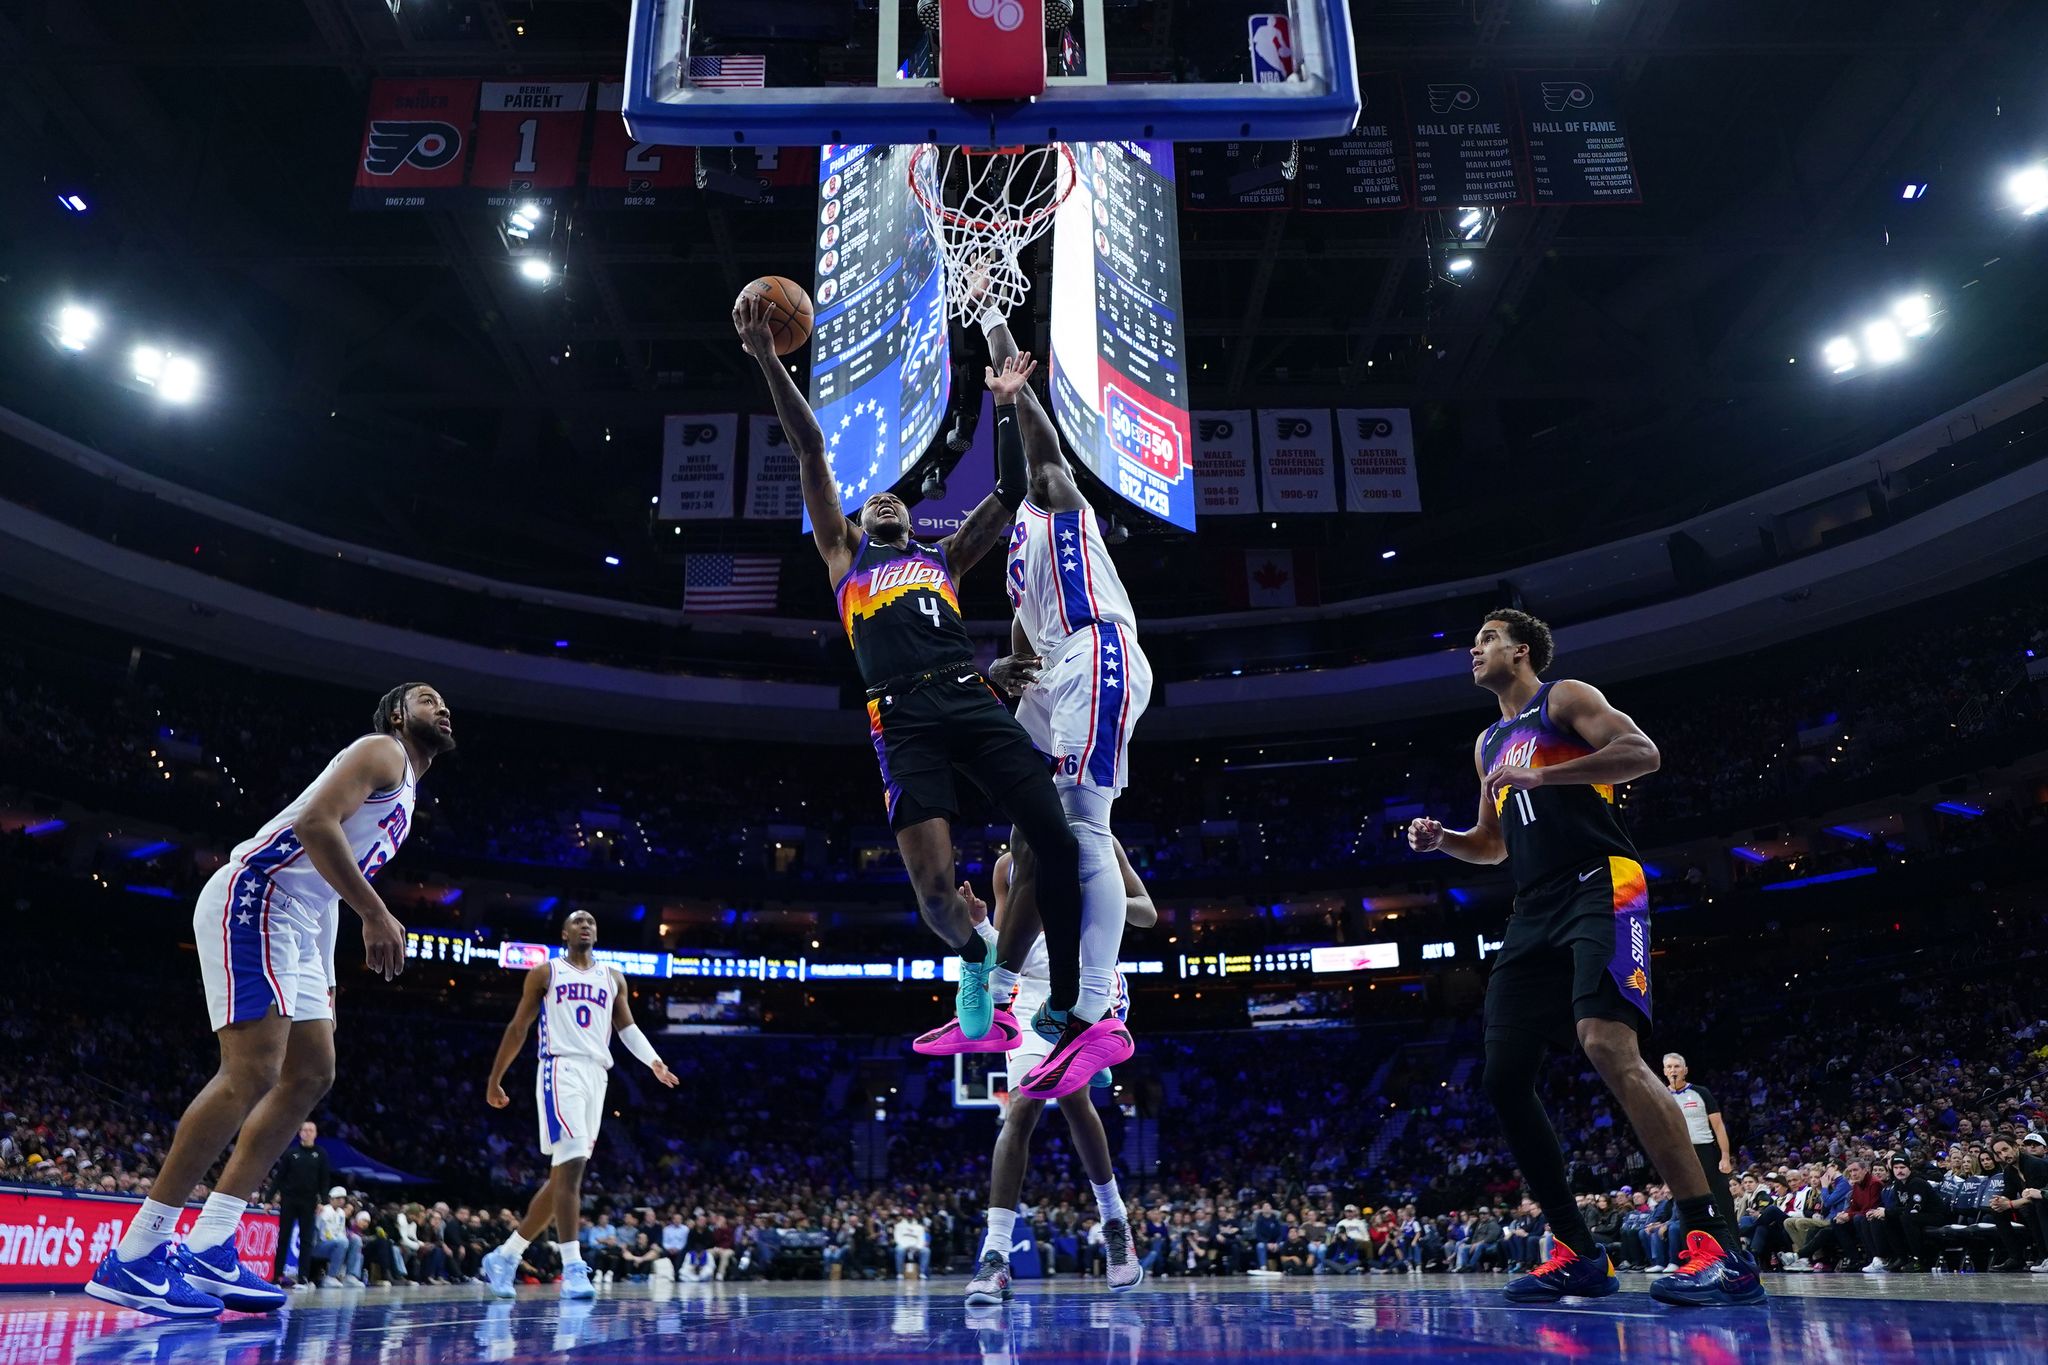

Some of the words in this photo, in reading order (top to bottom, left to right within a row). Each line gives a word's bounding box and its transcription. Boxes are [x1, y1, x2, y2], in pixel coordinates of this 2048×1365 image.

[519, 86, 551, 95] BERNIE
[504, 94, 563, 108] PARENT
[1356, 125, 1388, 136] FAME
[1417, 124, 1448, 135] HALL
[1449, 124, 1465, 134] OF
[1467, 123, 1501, 134] FAME
[1532, 122, 1562, 132] HALL
[1564, 122, 1581, 132] OF
[1582, 121, 1617, 132] FAME
[513, 119, 537, 172] 1
[1130, 141, 1152, 165] SUNS
[1490, 159, 1512, 168] HOWE
[1484, 181, 1515, 189] HEXTALL
[1483, 191, 1517, 200] SCHULTZ
[845, 294, 860, 309] TEAM
[861, 280, 880, 298] STATS
[1117, 278, 1133, 295] TEAM
[1133, 291, 1152, 308] STATS
[1116, 327, 1133, 346] TEAM
[1132, 339, 1159, 362] LEADERS
[839, 347, 857, 363] TEAM
[1112, 406, 1131, 438] 50
[1151, 432, 1174, 462] 50
[1203, 450, 1232, 459] WALES
[1276, 449, 1316, 458] EASTERN
[1358, 449, 1398, 457] EASTERN
[687, 455, 711, 463] WEST
[1193, 460, 1246, 468] CONFERENCE
[1269, 458, 1325, 467] CONFERENCE
[1351, 458, 1408, 466] CONFERENCE
[679, 464, 718, 472] DIVISION
[1194, 468, 1246, 477] CHAMPIONS
[1271, 467, 1325, 476] CHAMPIONS
[1353, 467, 1407, 476] CHAMPIONS
[671, 473, 724, 481] CHAMPIONS
[1363, 489, 1401, 499] 2009-10
[869, 561, 947, 597] Valley
[918, 597, 940, 627] 4
[1515, 789, 1537, 826] 11
[1630, 916, 1644, 967] SUNS
[555, 982, 608, 1009] PHILA
[576, 1004, 591, 1028] 0
[90, 1219, 123, 1265] #1
